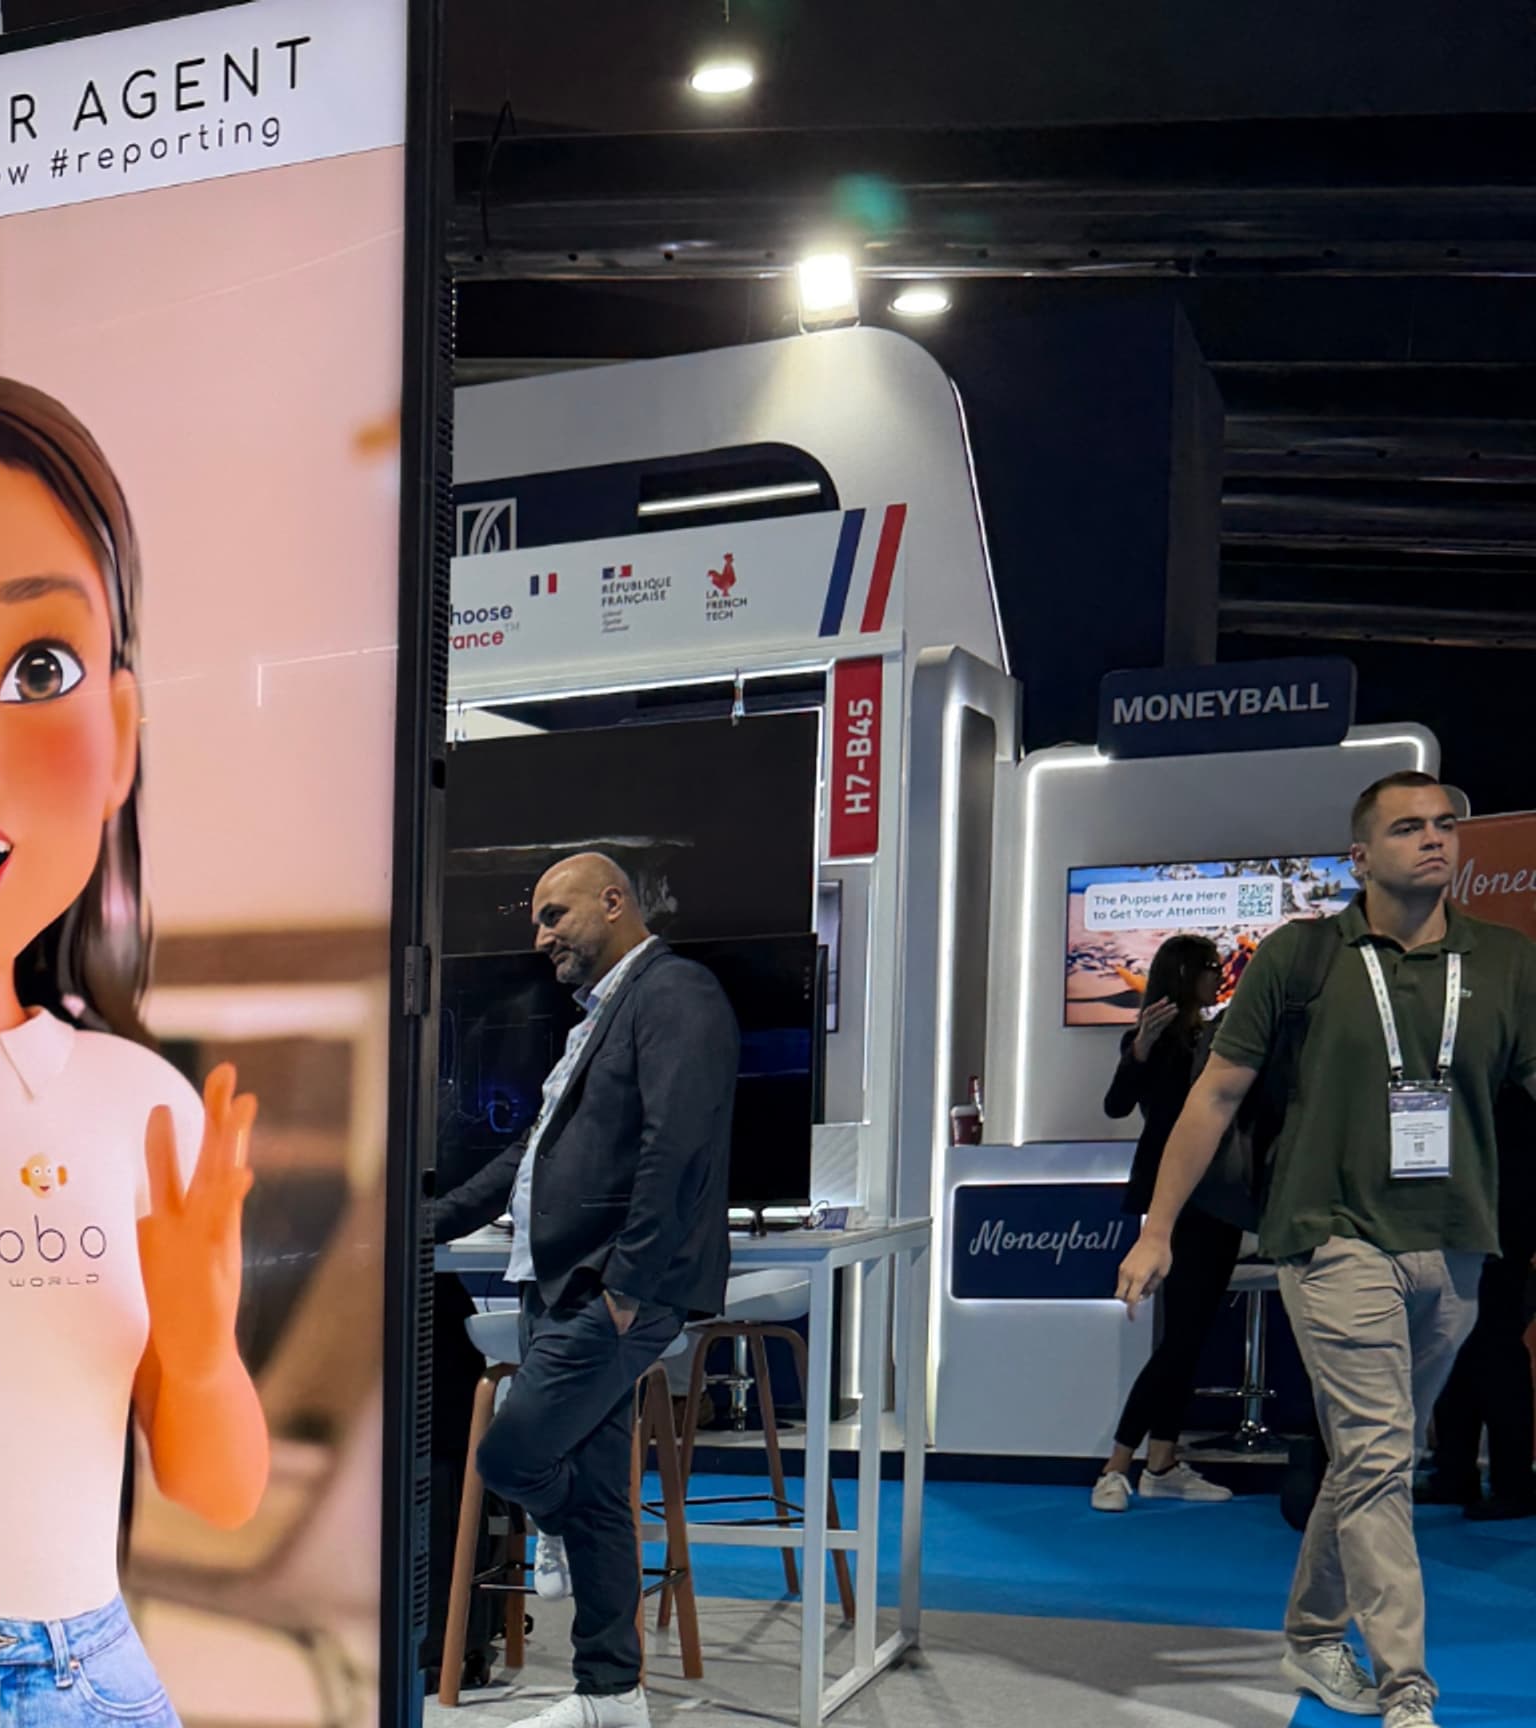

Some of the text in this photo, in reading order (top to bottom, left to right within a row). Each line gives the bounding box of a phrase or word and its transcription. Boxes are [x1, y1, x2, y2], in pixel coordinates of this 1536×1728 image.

[73, 36, 311, 131] AGENT
[50, 115, 282, 179] #reporting
[705, 590, 719, 599] LA
[705, 597, 748, 610] FRENCH
[705, 610, 734, 622] TECH
[1112, 682, 1330, 725] MONEYBALL
[843, 697, 875, 815] H7-B45
[1094, 890, 1228, 907] The Puppies Are Here
[1093, 904, 1226, 921] to Get Your Attention
[969, 1219, 1125, 1265] Moneyball
[8, 1273, 100, 1288] WORLD
